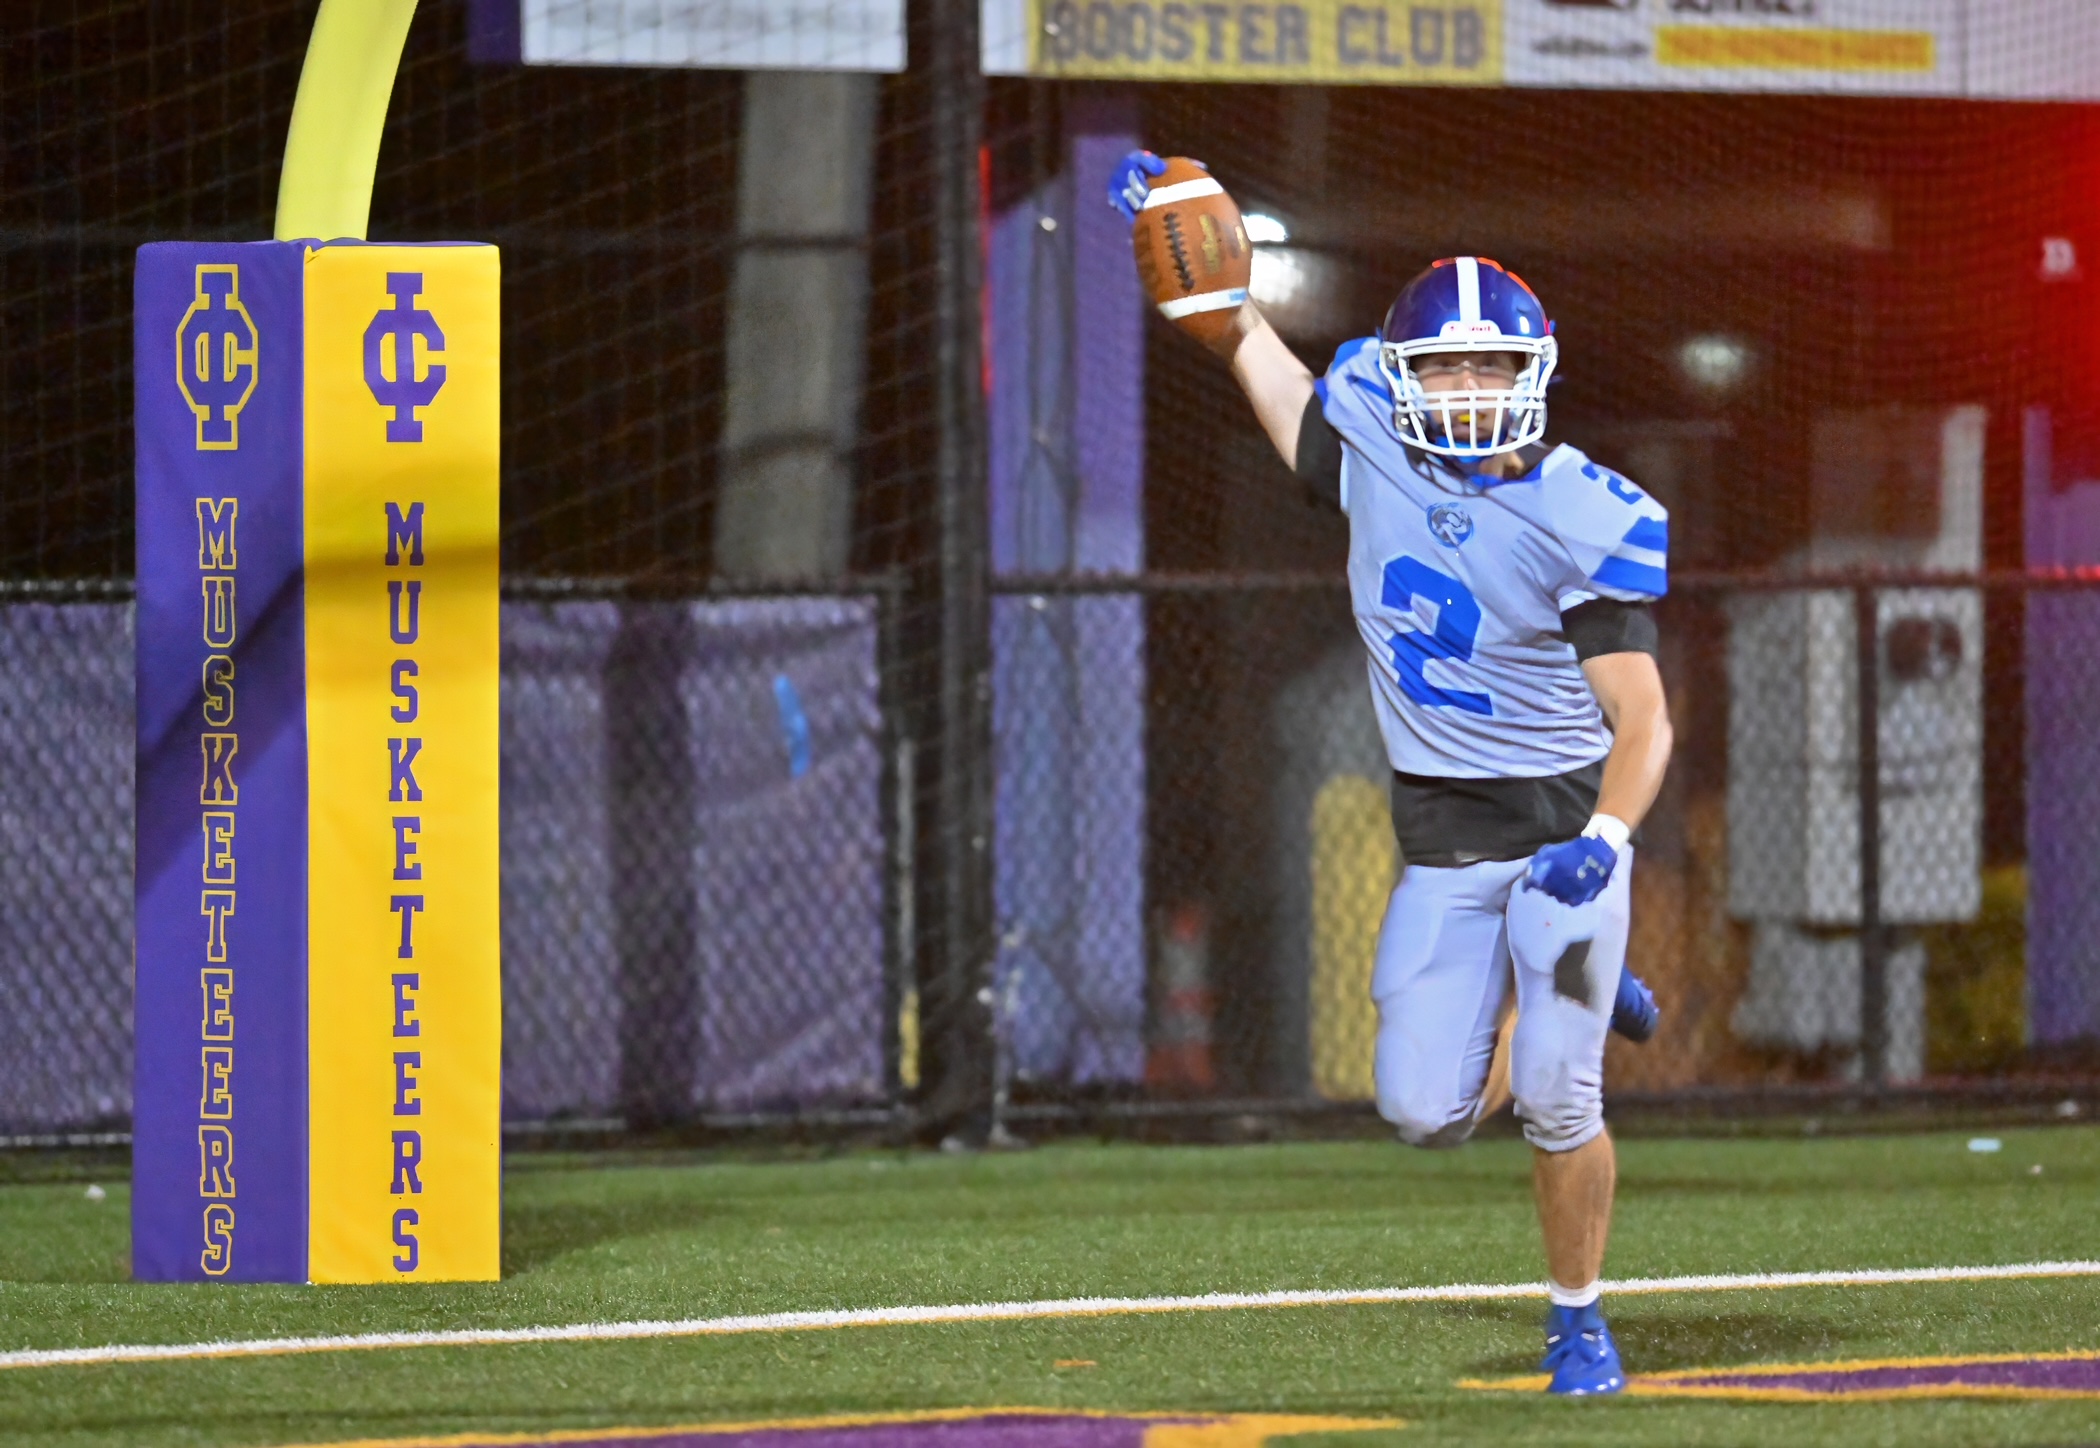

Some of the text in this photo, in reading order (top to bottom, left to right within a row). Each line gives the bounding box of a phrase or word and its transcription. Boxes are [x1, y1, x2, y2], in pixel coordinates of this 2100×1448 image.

[1050, 0, 1487, 69] BOOSTER CLUB
[1580, 461, 1644, 505] 2
[1380, 555, 1493, 716] 2
[195, 497, 239, 1276] MUSKETEERS
[384, 502, 425, 1273] MUSKETEERS
